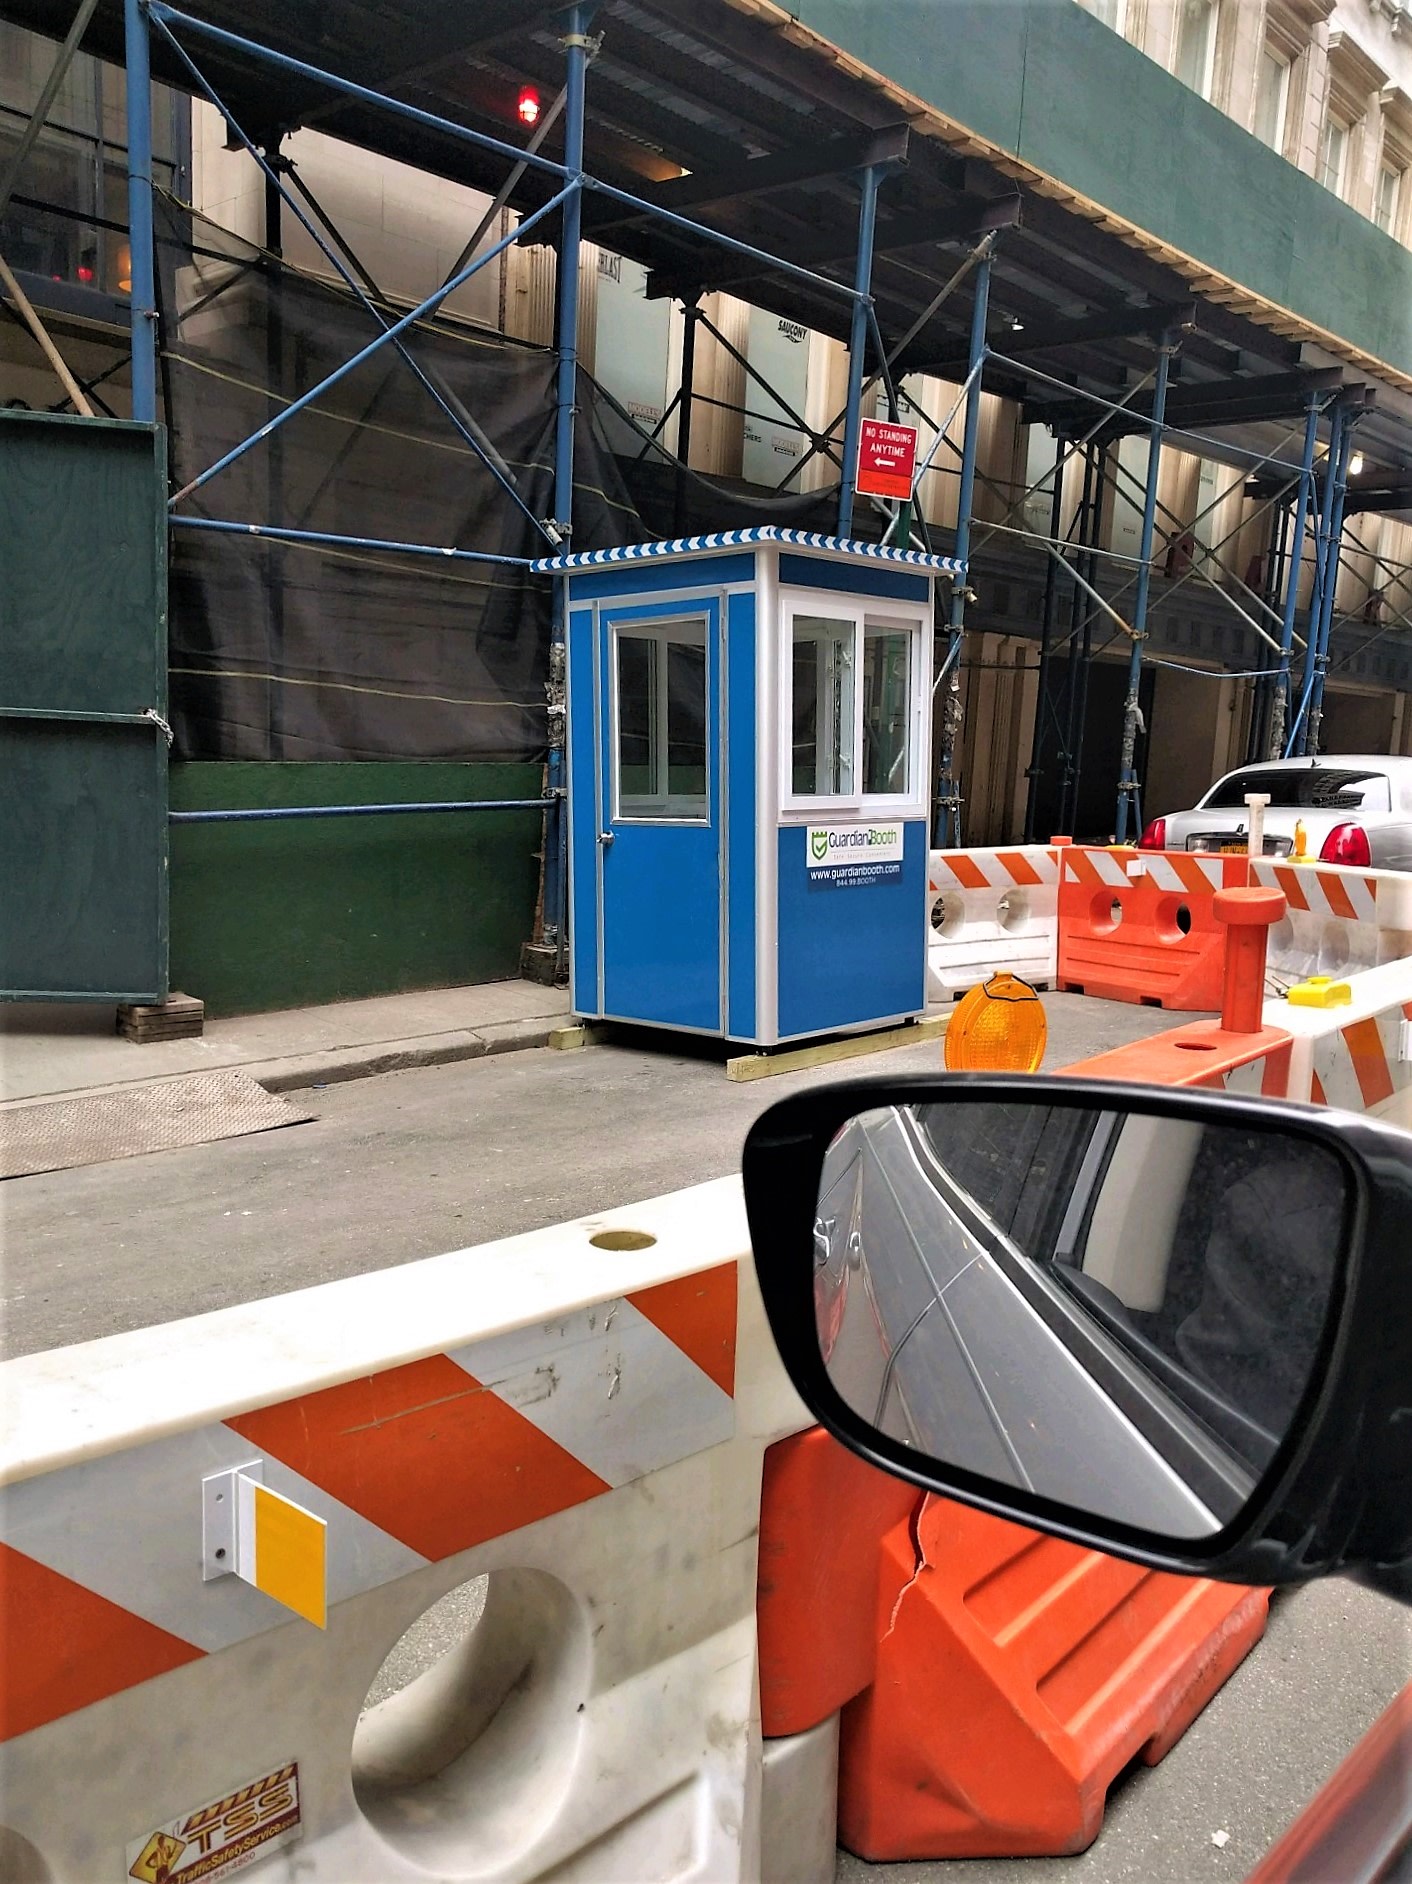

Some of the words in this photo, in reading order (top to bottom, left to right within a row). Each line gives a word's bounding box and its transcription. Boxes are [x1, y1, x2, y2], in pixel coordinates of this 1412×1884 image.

[778, 319, 808, 340] SAUCONY
[865, 427, 876, 438] NO
[879, 429, 912, 445] STANDING
[870, 443, 906, 458] ANYTIME
[810, 864, 900, 880] www.guardianbooth.com
[186, 1782, 293, 1854] TSS
